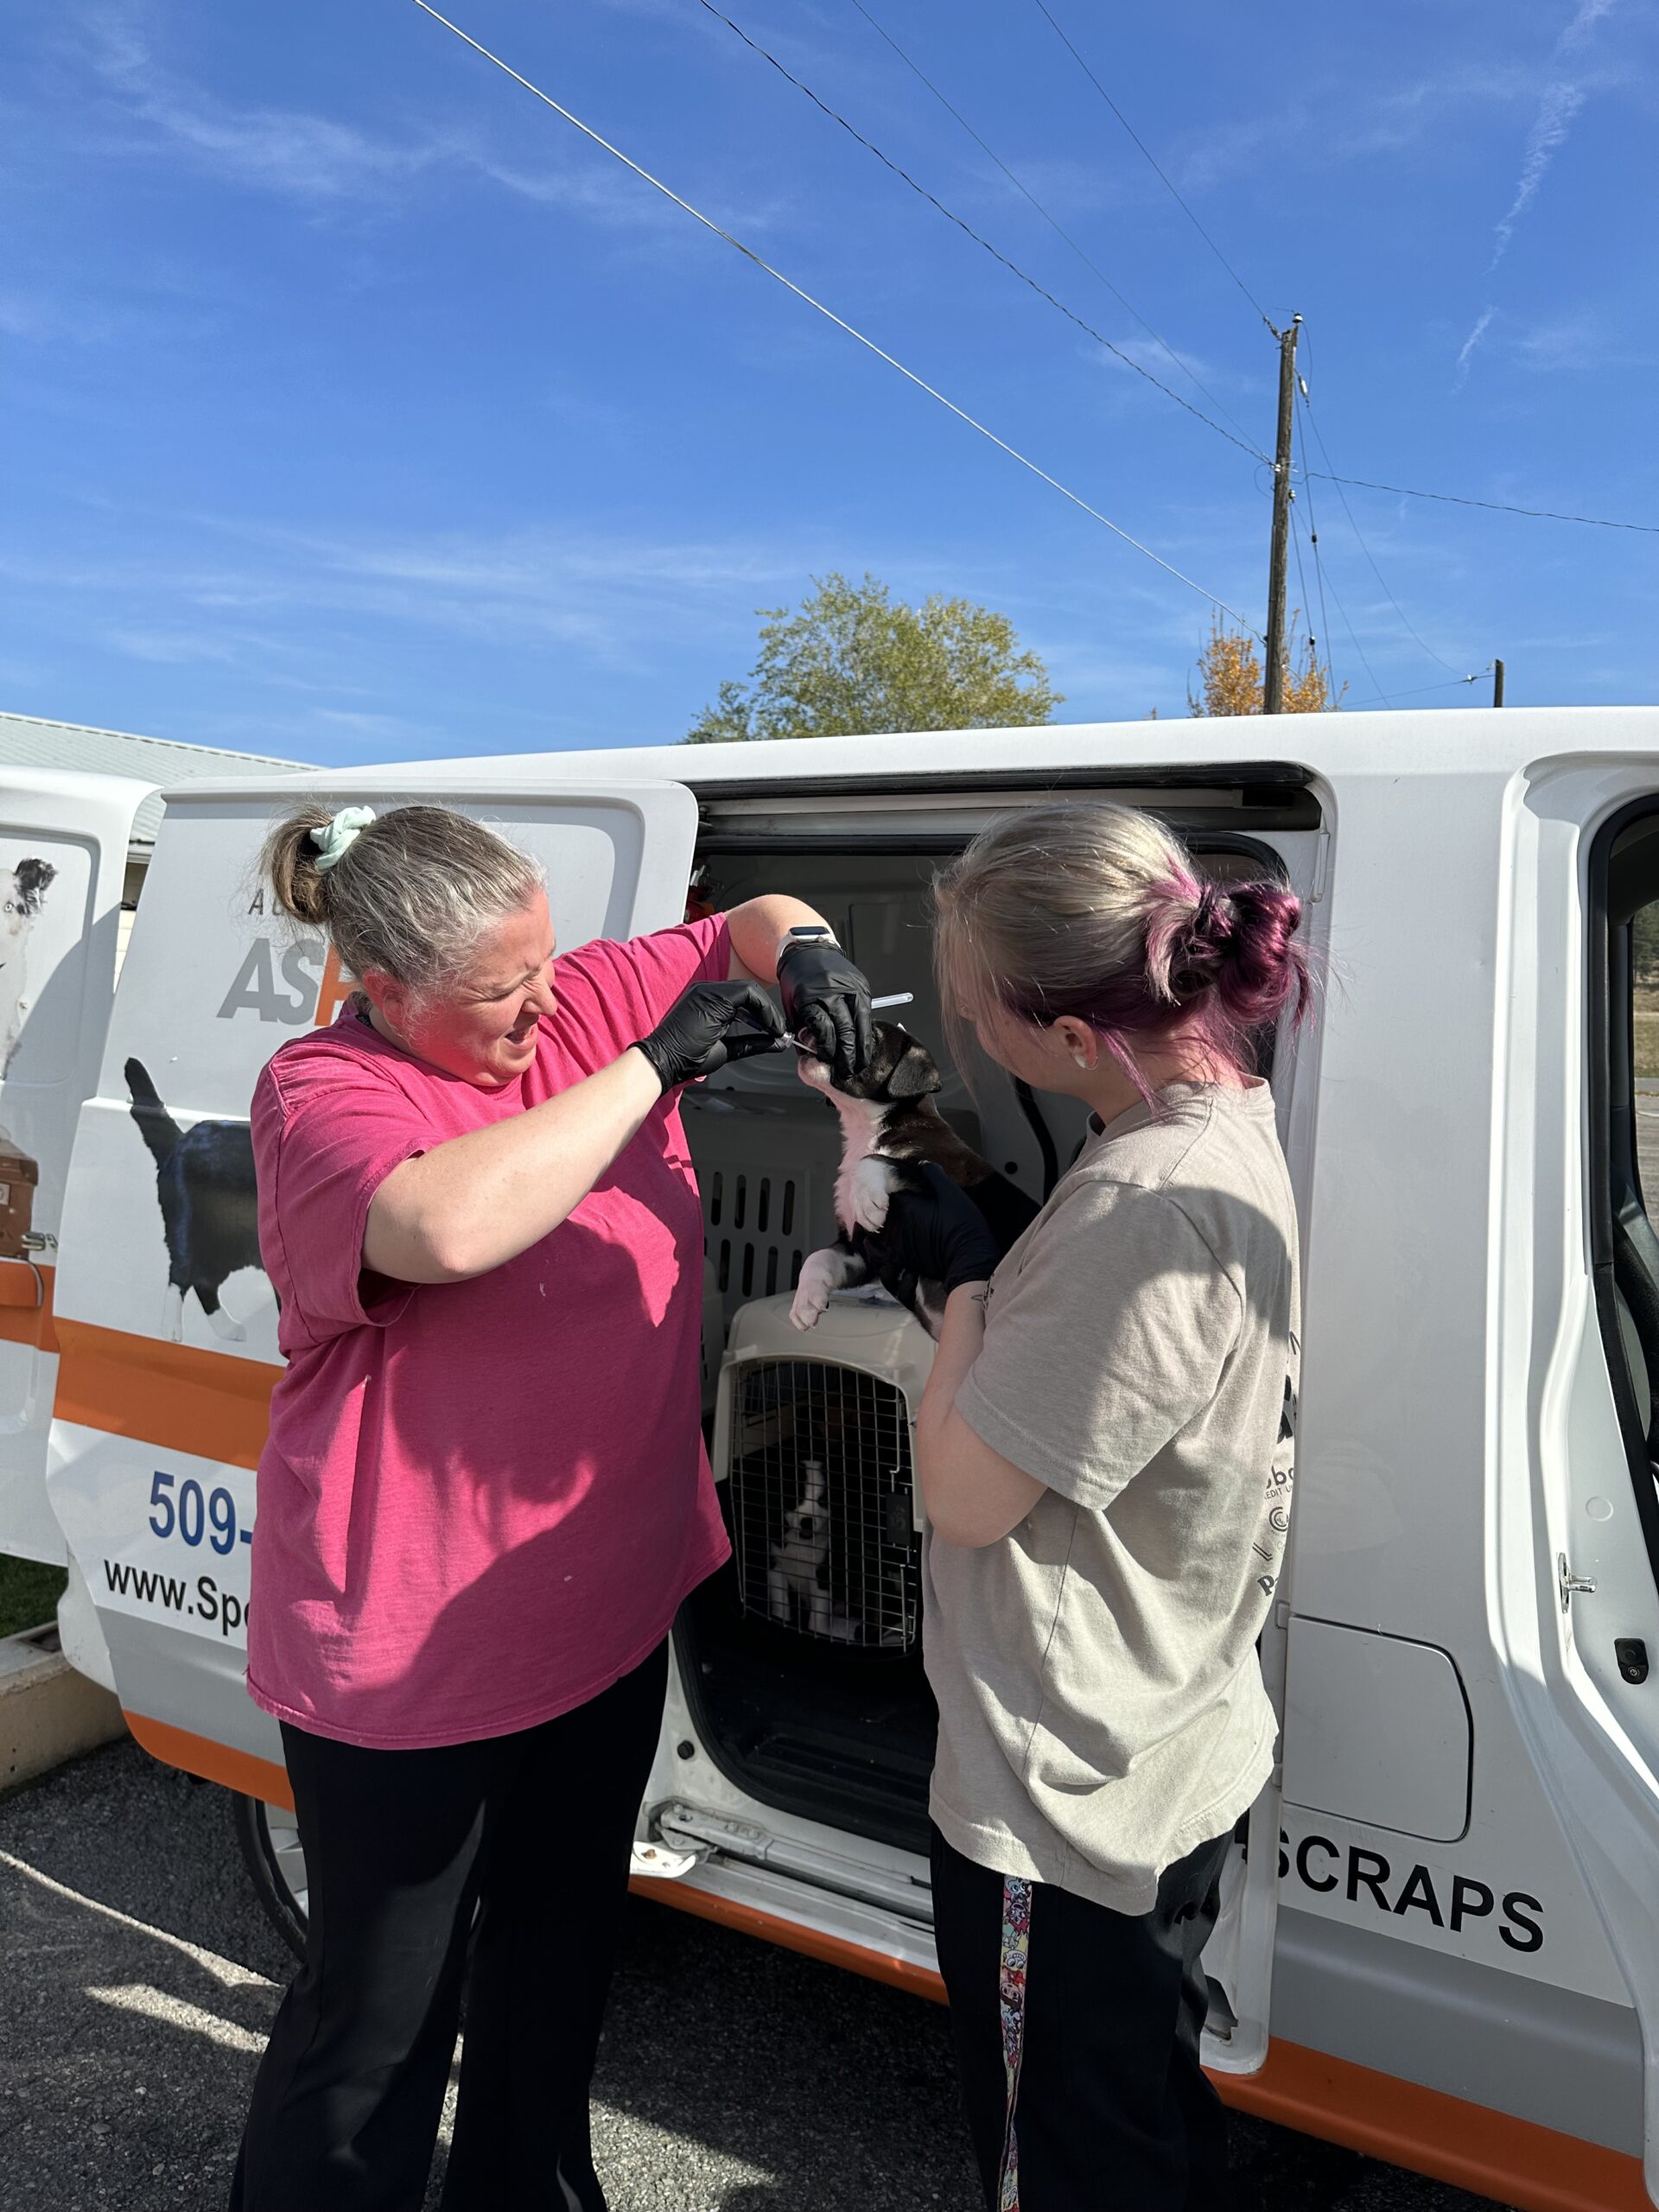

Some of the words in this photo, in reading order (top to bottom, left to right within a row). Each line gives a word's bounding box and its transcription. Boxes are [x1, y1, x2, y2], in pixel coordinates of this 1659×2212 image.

[1264, 1487, 1282, 1500] EDIT
[104, 1559, 250, 1637] www.Sp
[1278, 1826, 1544, 1953] CRAPS
